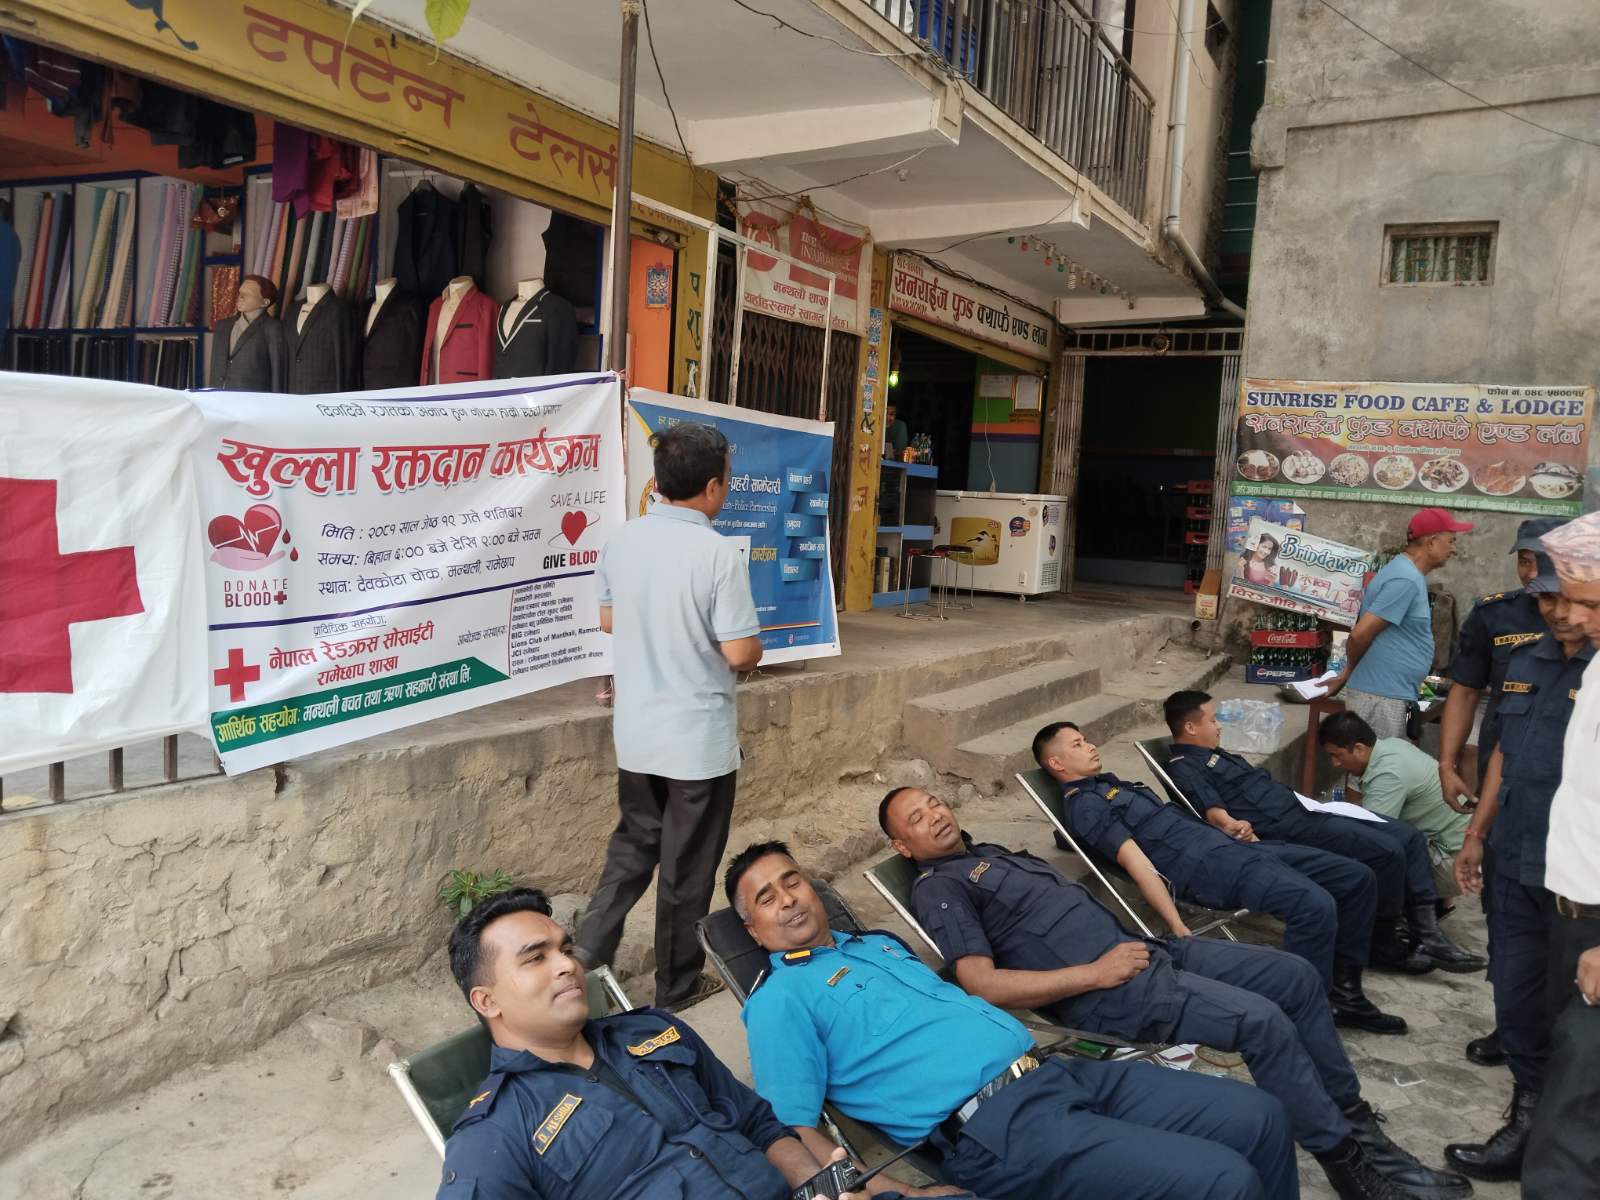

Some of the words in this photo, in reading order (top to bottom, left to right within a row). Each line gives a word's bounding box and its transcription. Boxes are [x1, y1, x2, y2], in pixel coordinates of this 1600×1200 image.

[1247, 391, 1338, 408] SUNRISE
[1343, 394, 1405, 411] FOOD
[1412, 396, 1470, 413] CAFE
[1476, 398, 1494, 414] &
[1500, 399, 1584, 416] LODGE
[216, 438, 361, 497] खुल्ला
[371, 443, 491, 492] रक्तदान
[490, 427, 601, 475] कार्यक्रम
[550, 492, 573, 508] SAVE
[574, 491, 581, 505] A
[584, 490, 606, 505] LIFE
[428, 537, 449, 554] बजे
[1279, 533, 1370, 578] Brindawan
[543, 553, 566, 569] GIVE
[569, 550, 600, 566] BLOO
[224, 578, 288, 592] DONATE
[225, 591, 271, 608] BLOOD
[269, 646, 317, 670] नेपाल
[319, 635, 380, 662] रेडक्रस
[511, 640, 528, 649] Lions
[528, 635, 543, 645] Club
[543, 634, 550, 642] of
[316, 660, 367, 686] रामेछाप
[369, 655, 400, 675] शाखा
[302, 694, 340, 722] मन्थली
[341, 694, 363, 714] बचत
[364, 689, 382, 708] तथा
[404, 676, 438, 698] सहकारी
[437, 669, 459, 689] संस्था
